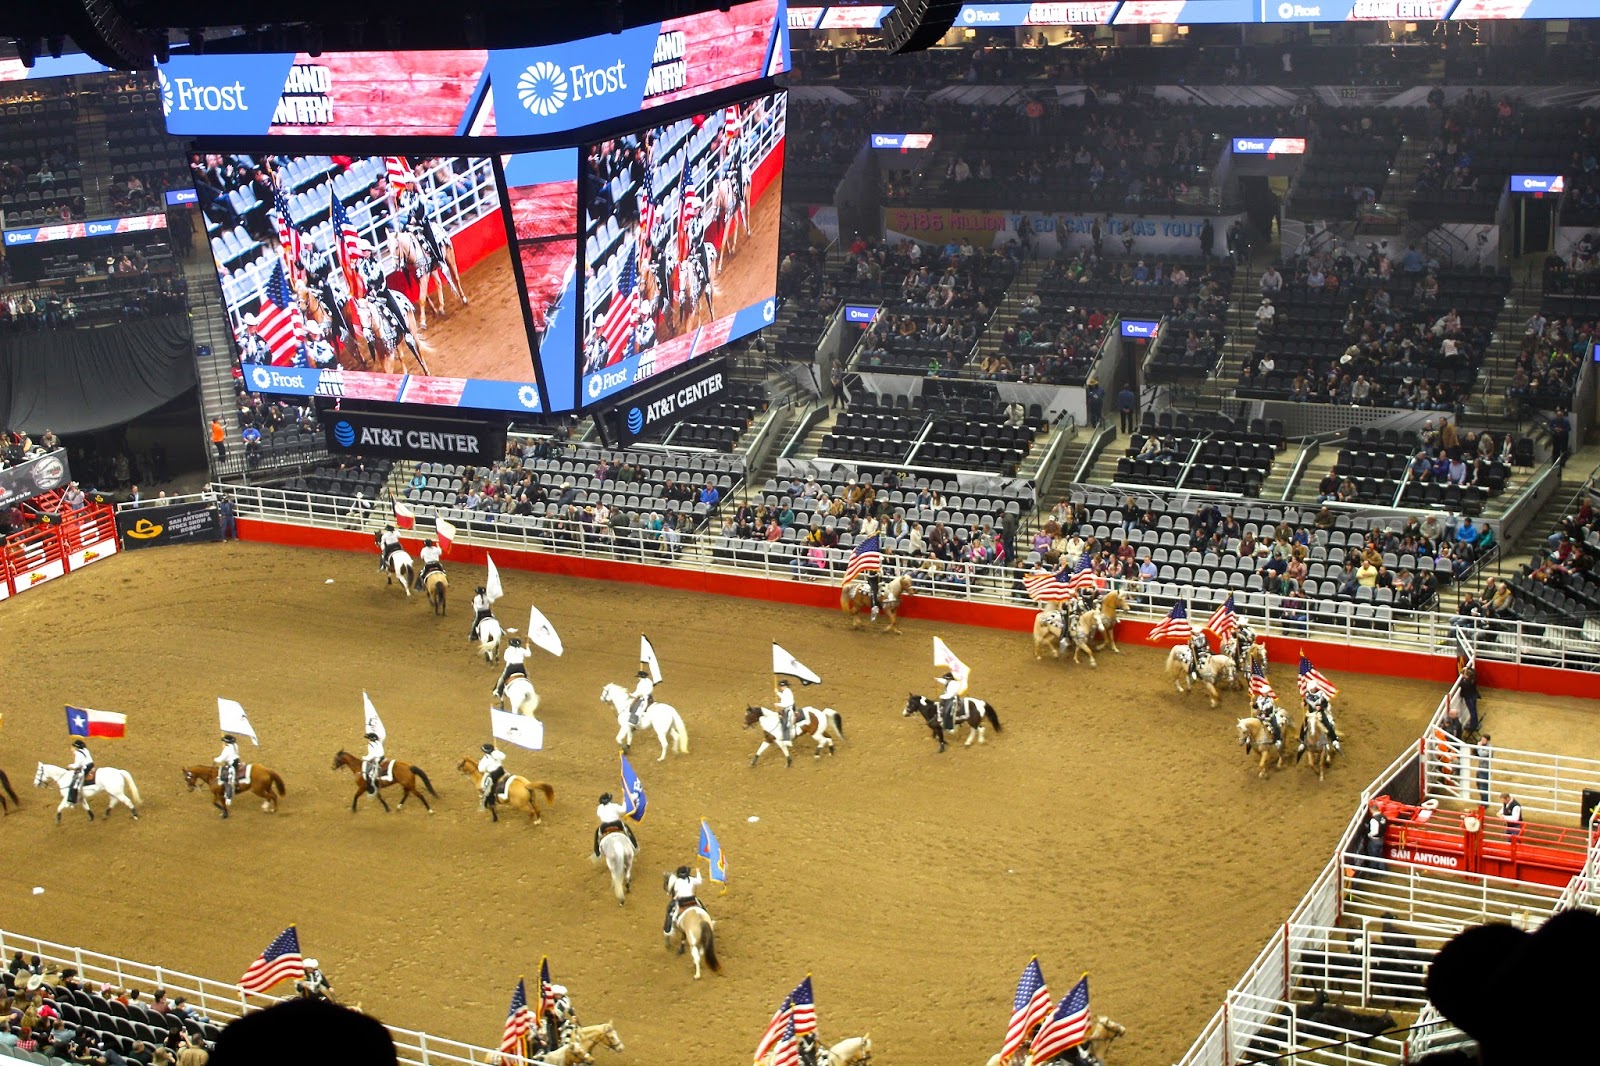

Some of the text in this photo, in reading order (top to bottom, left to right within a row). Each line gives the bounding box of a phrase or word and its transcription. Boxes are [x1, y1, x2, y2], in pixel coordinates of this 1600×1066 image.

[569, 58, 627, 102] Frost
[174, 78, 249, 111] Frost
[896, 211, 944, 231] $186
[950, 214, 1006, 231] MILLION
[1159, 221, 1203, 238] YOUT
[270, 371, 305, 389] Frost
[603, 367, 627, 390] Frost
[646, 373, 724, 425] AT&T CENTER
[360, 426, 480, 454] AT&T CENTER
[168, 522, 188, 531] STOCK
[188, 518, 207, 526] SHOW
[183, 511, 210, 522] ANTONIO
[180, 524, 201, 533] RODEO
[1390, 848, 1458, 867] SAN ANTONIO
